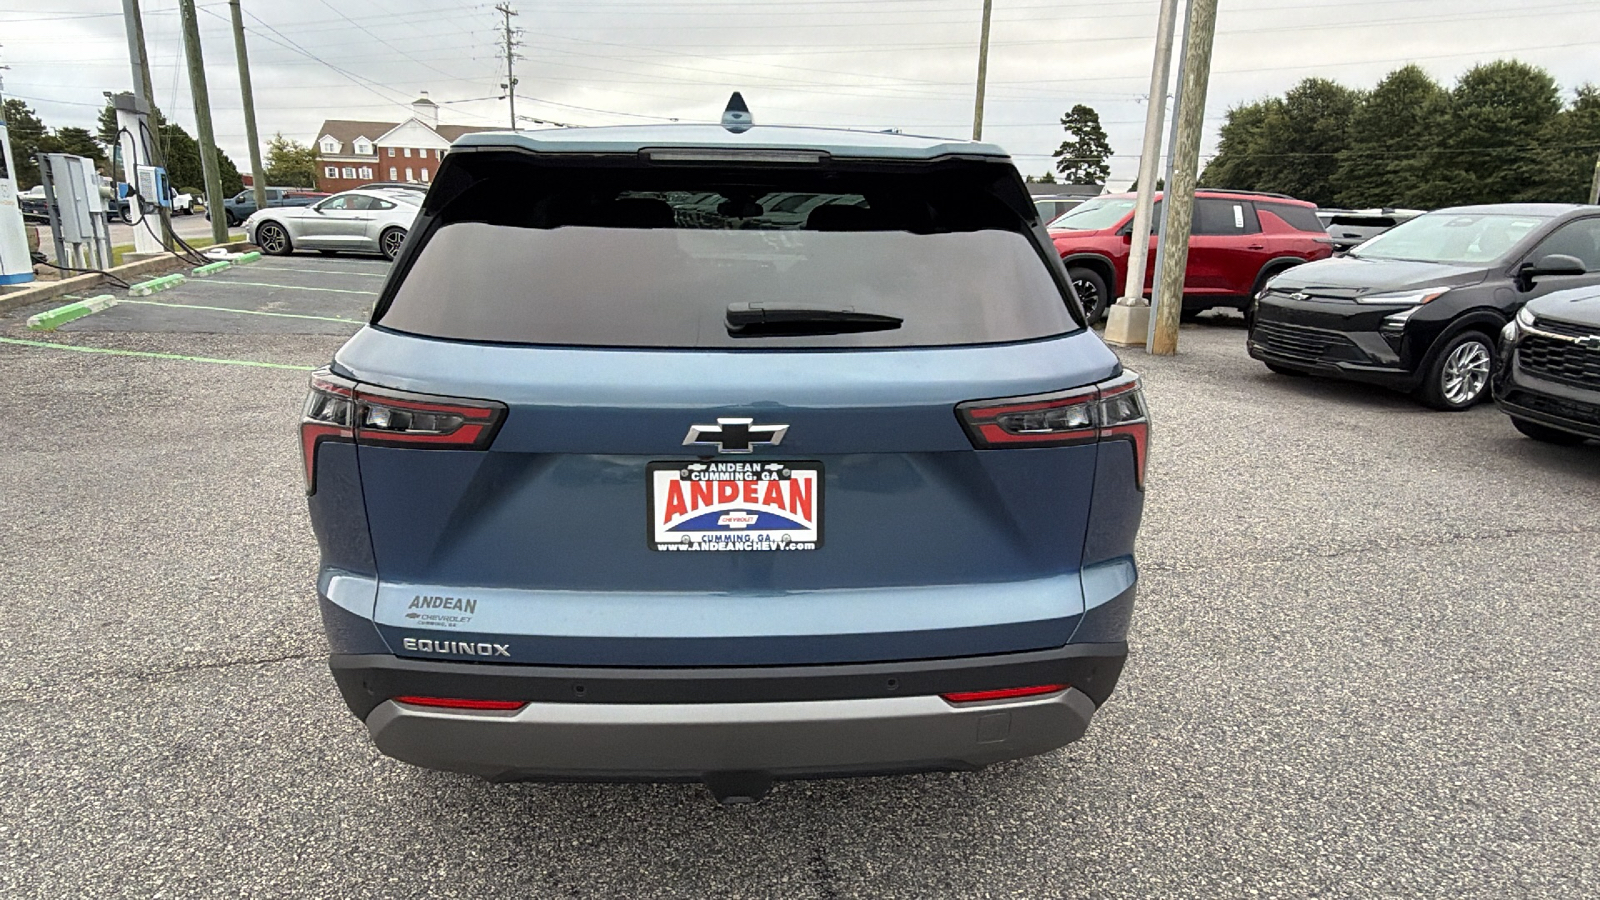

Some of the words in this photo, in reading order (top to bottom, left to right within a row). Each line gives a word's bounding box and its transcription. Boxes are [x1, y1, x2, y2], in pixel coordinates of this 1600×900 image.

[708, 463, 761, 472] ANDEAN
[691, 472, 757, 481] CUMMING,
[761, 472, 779, 481] GA
[663, 478, 812, 525] ANDEAN
[657, 541, 815, 551] www.ANDEANCHEVY.com
[408, 595, 477, 614] ANDEAN
[421, 614, 472, 622] CHEVROLET
[403, 638, 511, 656] EQUINOX
